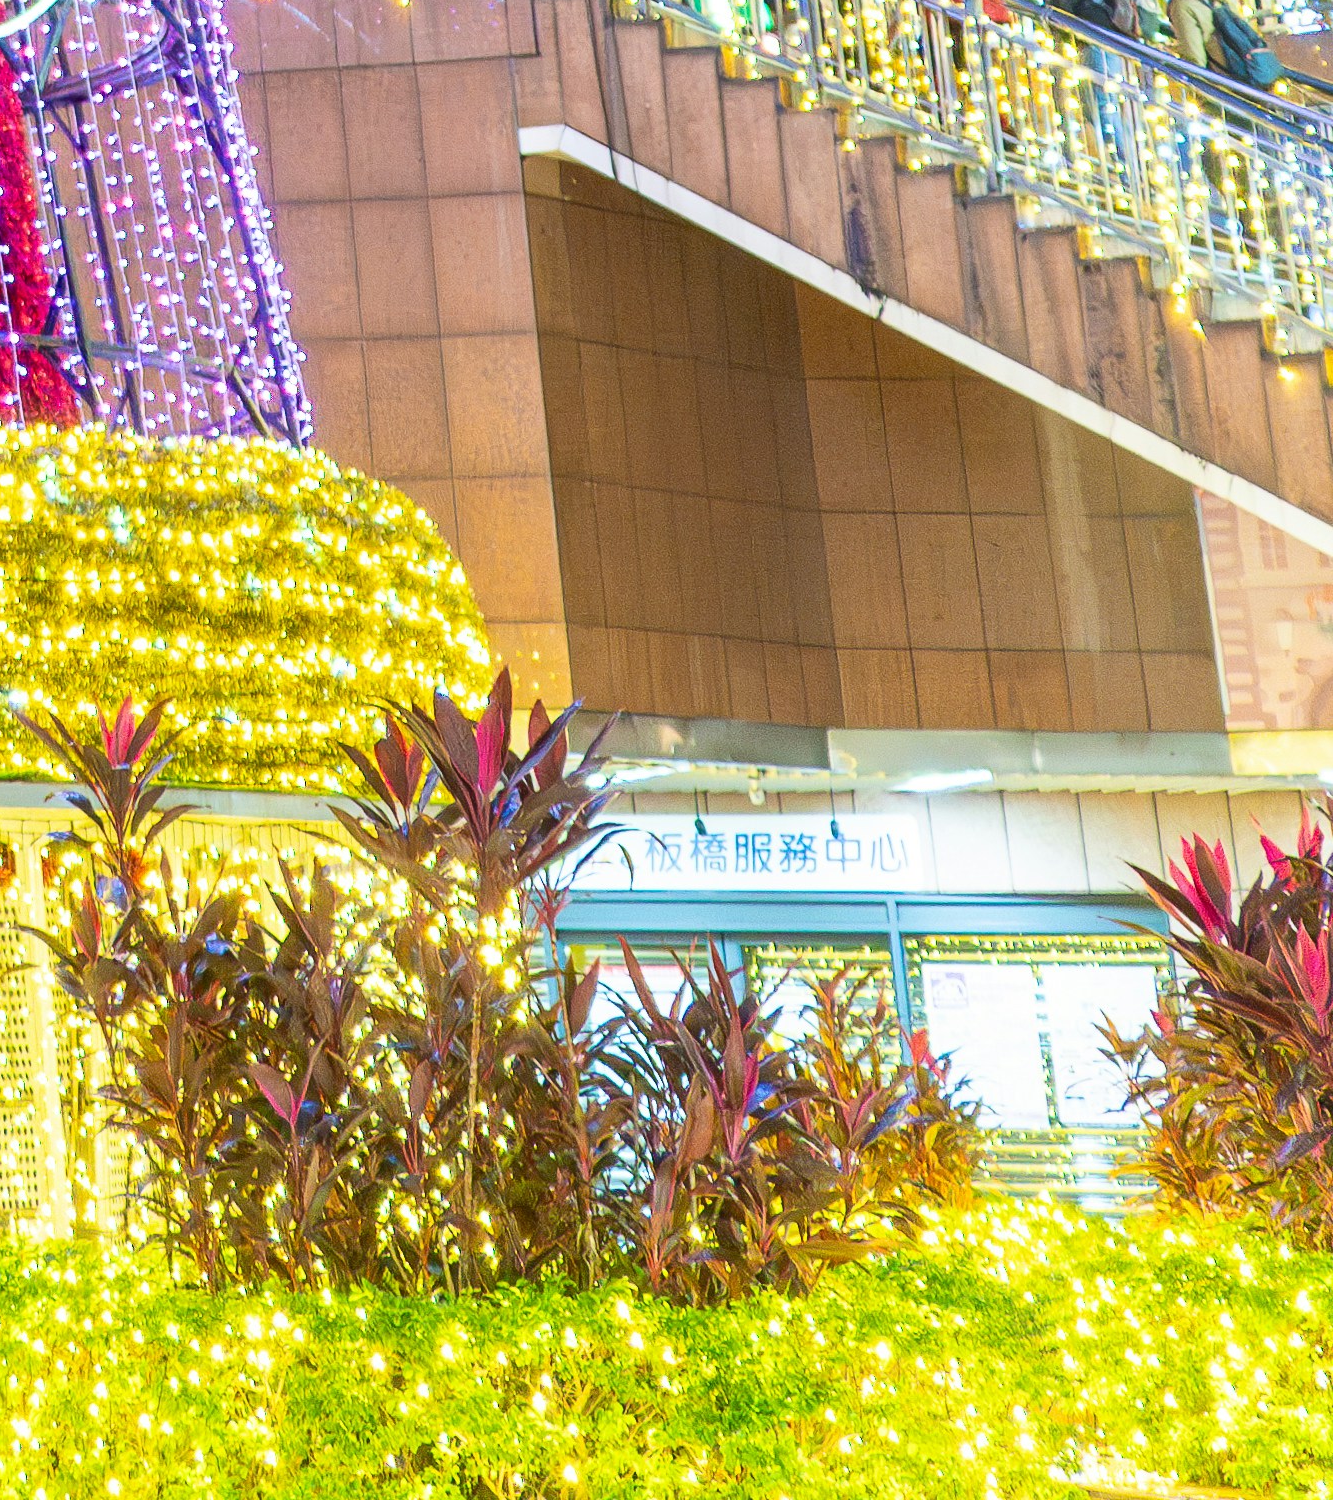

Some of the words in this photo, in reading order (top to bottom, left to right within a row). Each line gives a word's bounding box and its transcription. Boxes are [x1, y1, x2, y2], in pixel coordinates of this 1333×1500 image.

[644, 831, 909, 874] 板橋服務中心
